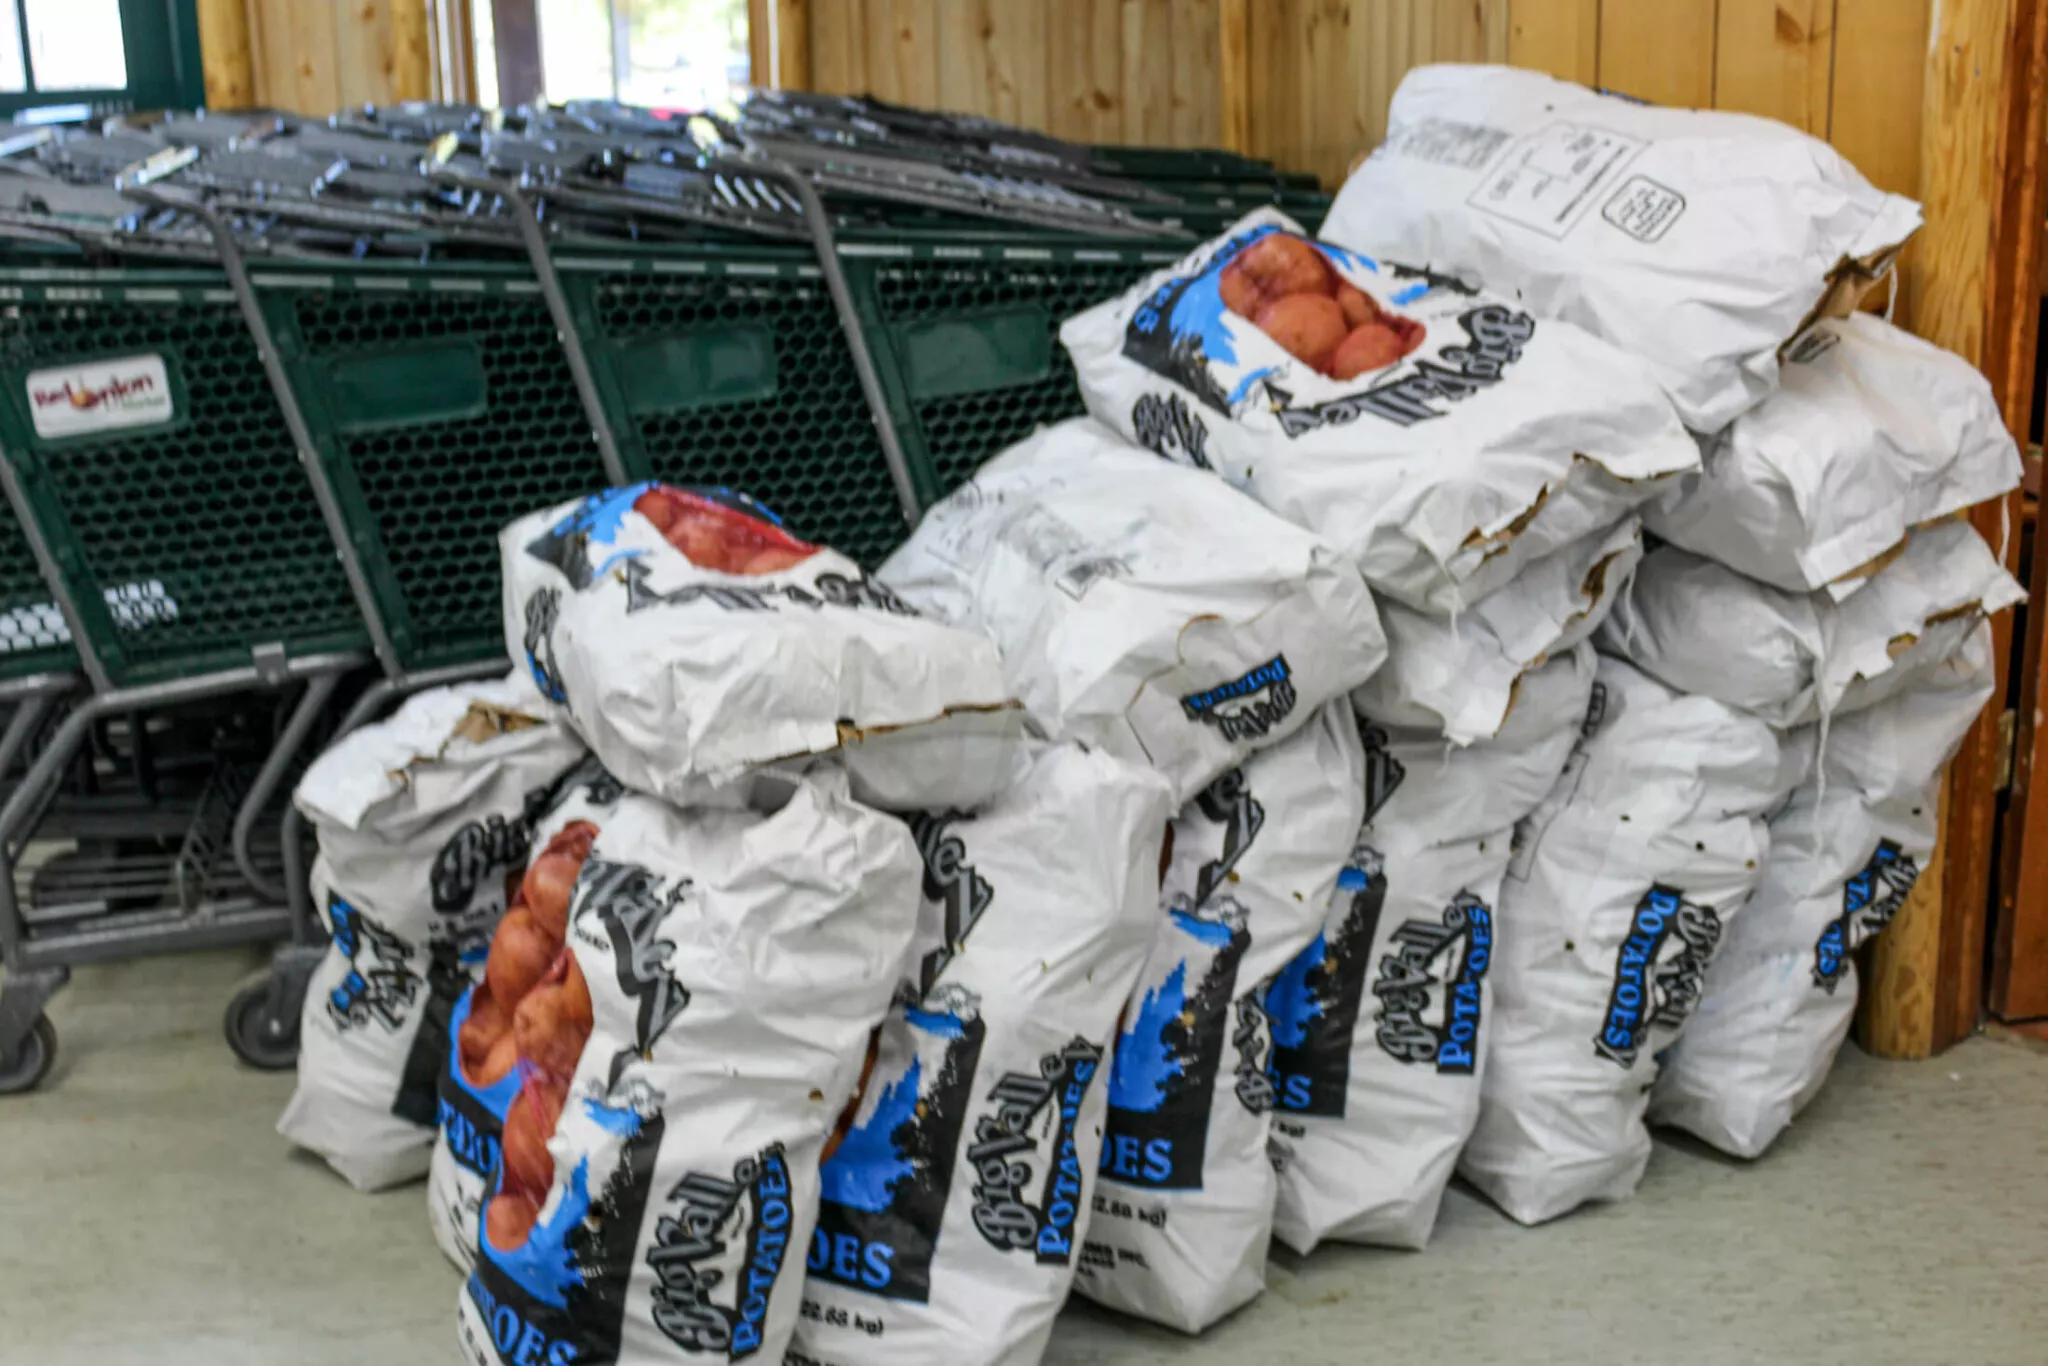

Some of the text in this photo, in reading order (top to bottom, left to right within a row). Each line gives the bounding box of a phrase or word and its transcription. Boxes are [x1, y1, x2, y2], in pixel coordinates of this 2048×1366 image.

[1438, 905, 1491, 1067] POTAOES
[1605, 890, 1682, 1048] POTATOES
[645, 1140, 784, 1266] Valle
[966, 1035, 1104, 1252] Big Valley
